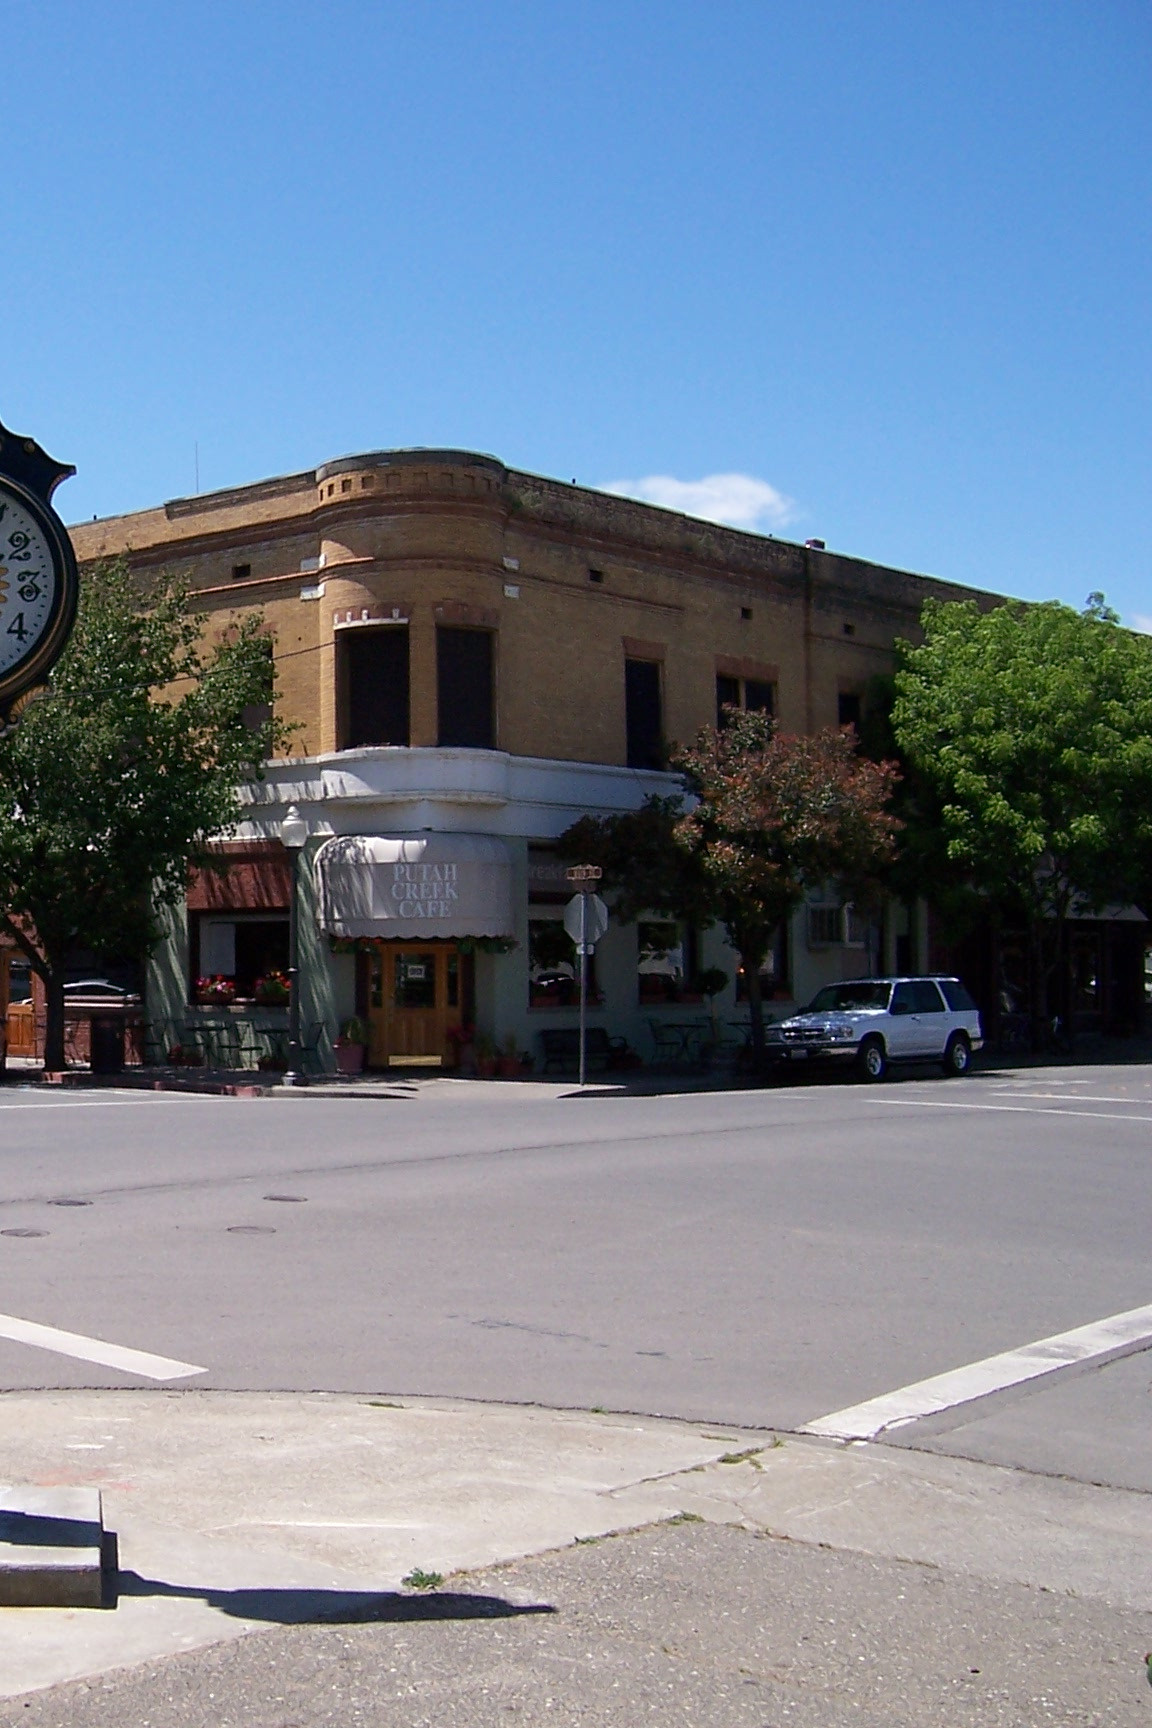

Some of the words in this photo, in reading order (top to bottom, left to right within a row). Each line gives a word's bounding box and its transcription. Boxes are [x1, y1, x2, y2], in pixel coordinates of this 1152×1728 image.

[8, 531, 31, 561] 2
[17, 570, 41, 602] 3
[7, 612, 29, 640] 4
[393, 863, 457, 882] PUTAH
[391, 882, 458, 900] CREEK
